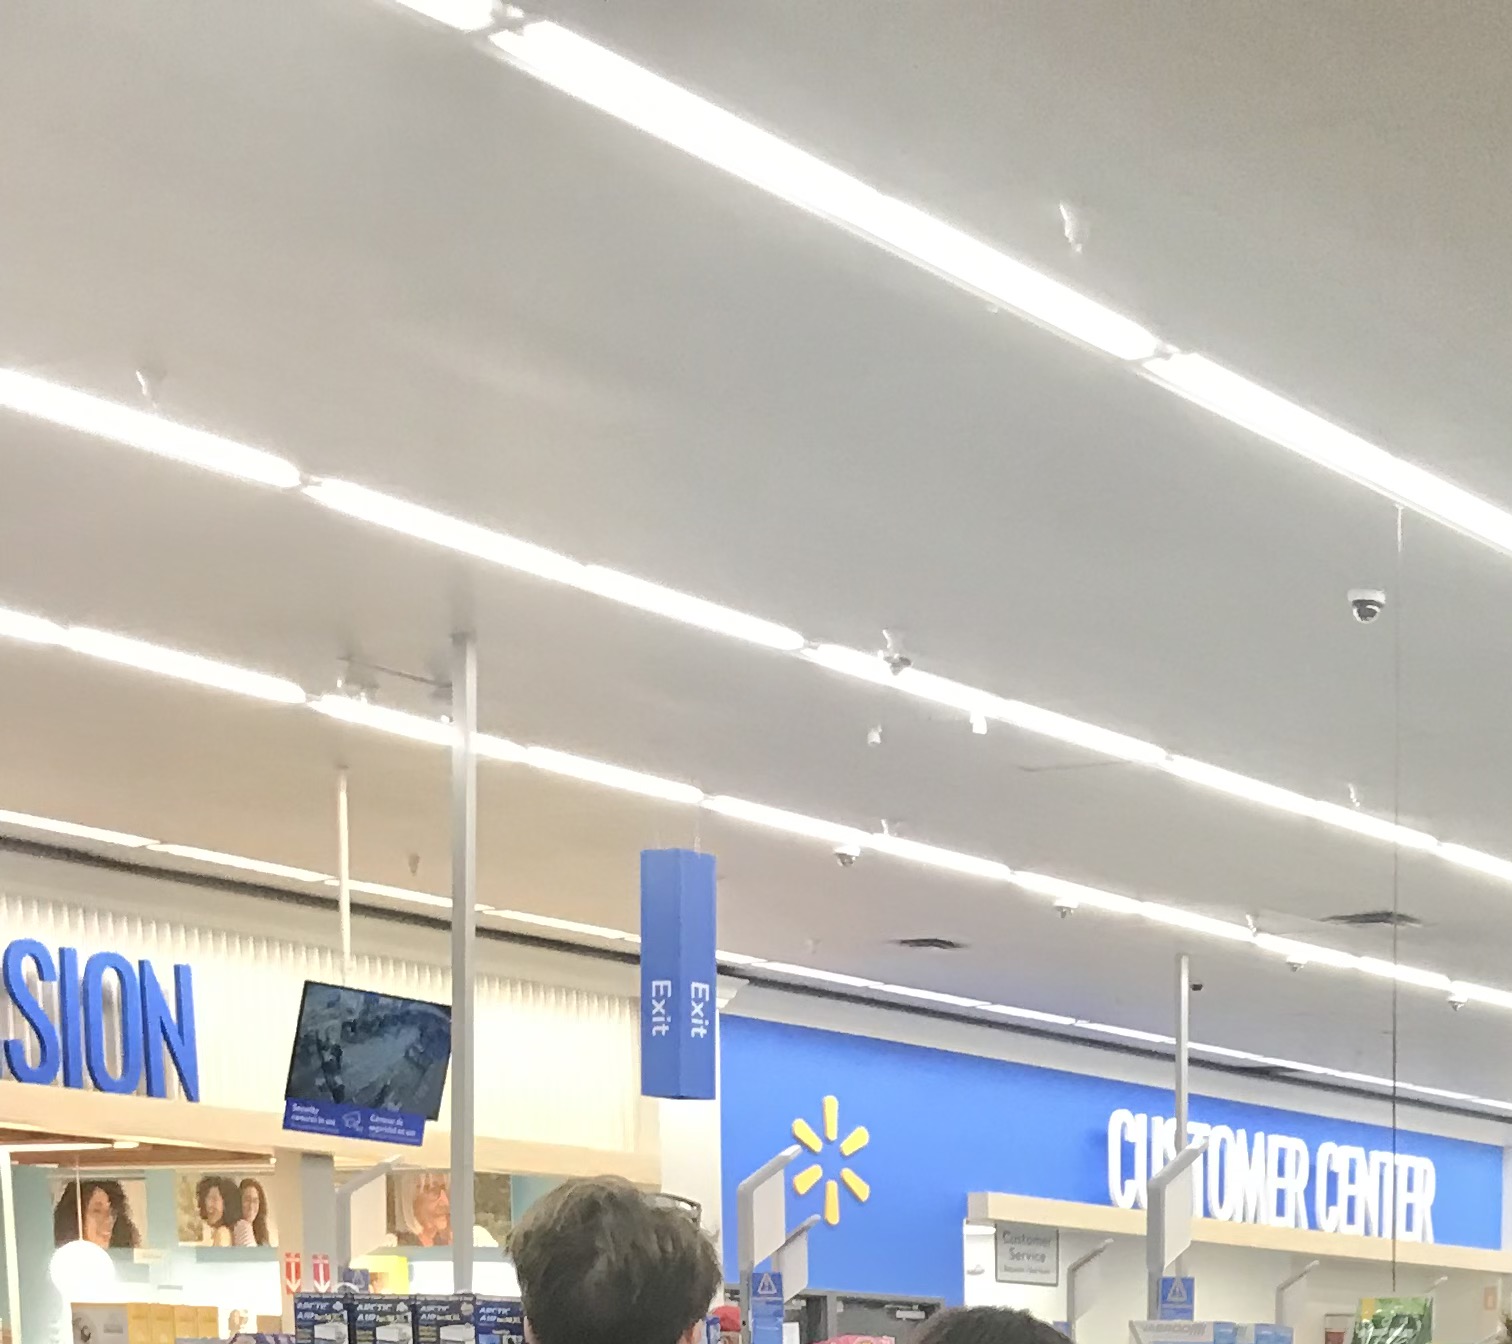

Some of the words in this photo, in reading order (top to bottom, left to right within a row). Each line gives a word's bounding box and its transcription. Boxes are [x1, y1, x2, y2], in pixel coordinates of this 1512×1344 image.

[652, 980, 671, 1036] Exit
[691, 982, 709, 1038] Exit
[1315, 1141, 1437, 1244] CENTER
[1002, 1230, 1051, 1247] Customer
[1009, 1247, 1046, 1263] Service
